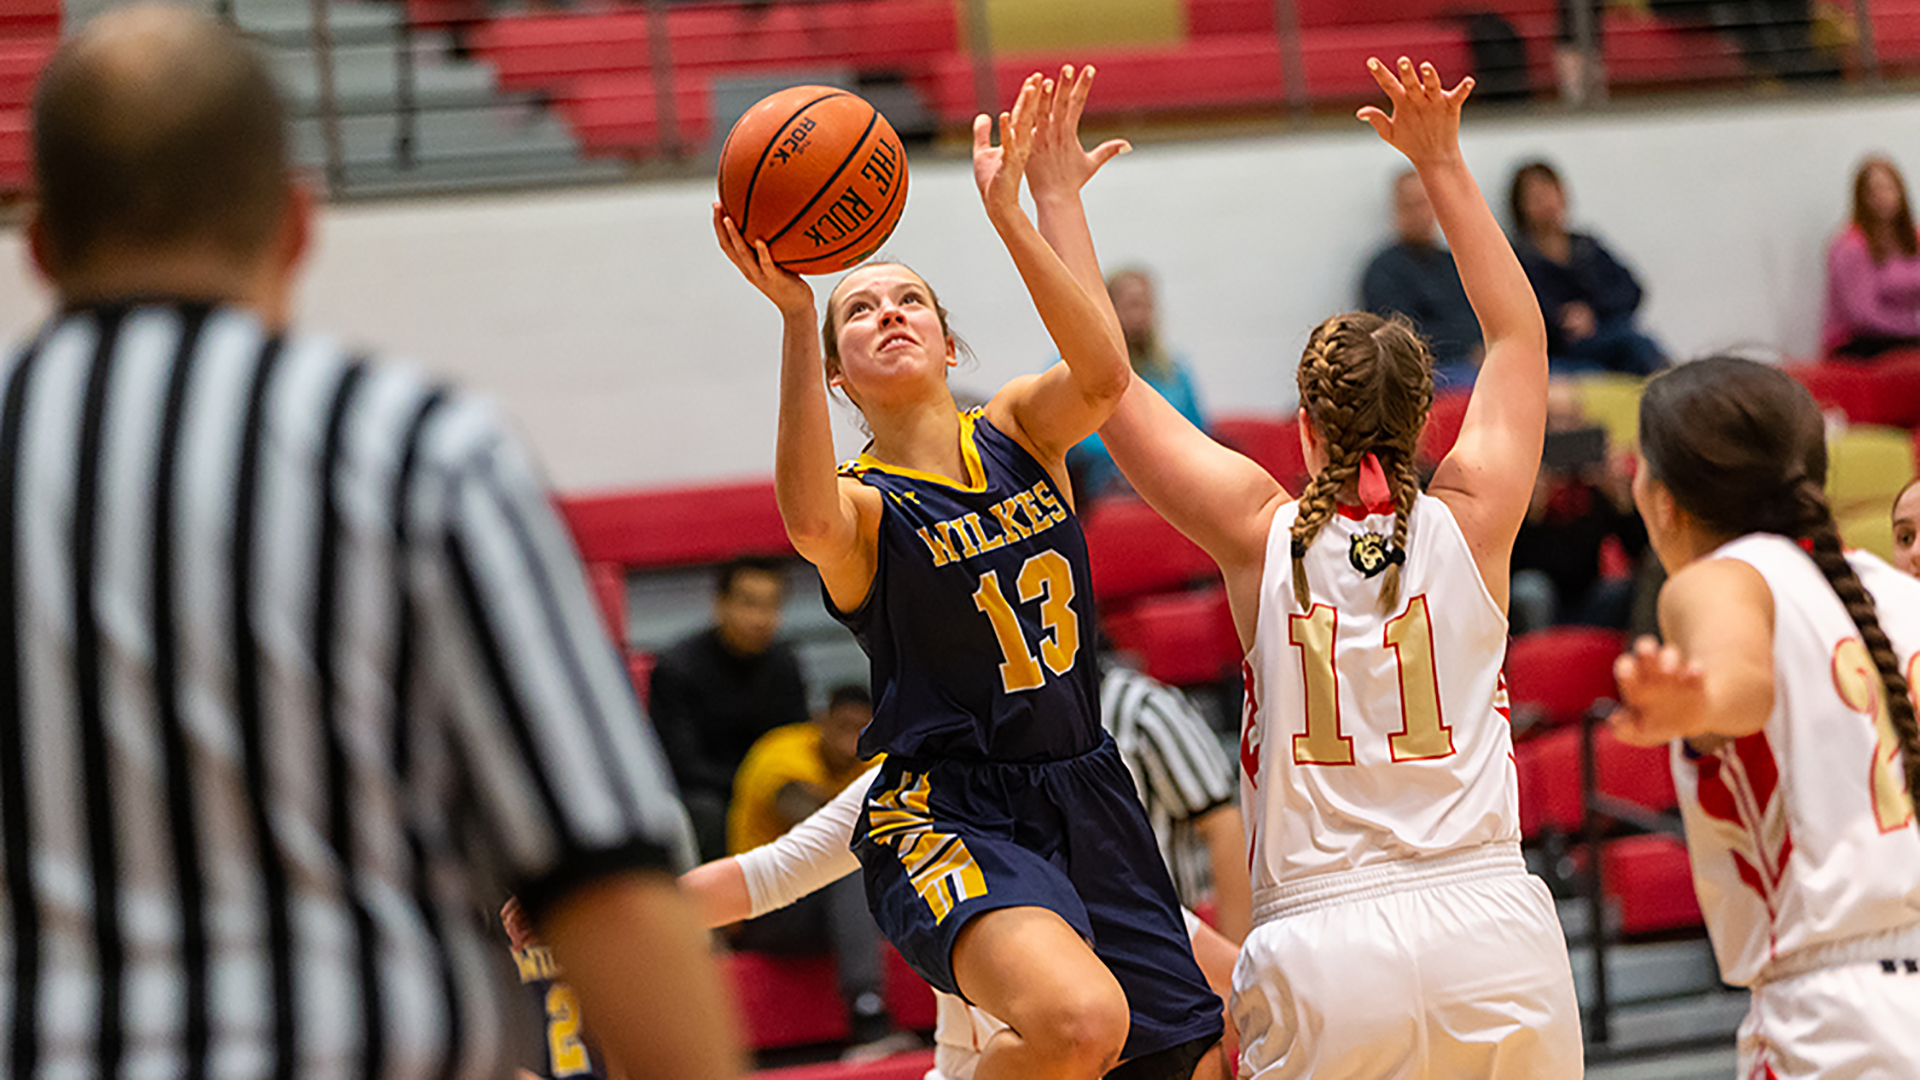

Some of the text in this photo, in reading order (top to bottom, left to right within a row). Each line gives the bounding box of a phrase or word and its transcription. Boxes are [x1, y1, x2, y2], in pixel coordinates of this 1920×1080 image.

[773, 116, 817, 165] ROCK
[861, 137, 897, 196] THE
[803, 185, 874, 247] ROCK
[917, 480, 1067, 567] WILKES
[972, 548, 1080, 694] 13
[1288, 593, 1457, 766] 11
[1831, 636, 1920, 835] 2
[509, 943, 564, 984] WIL
